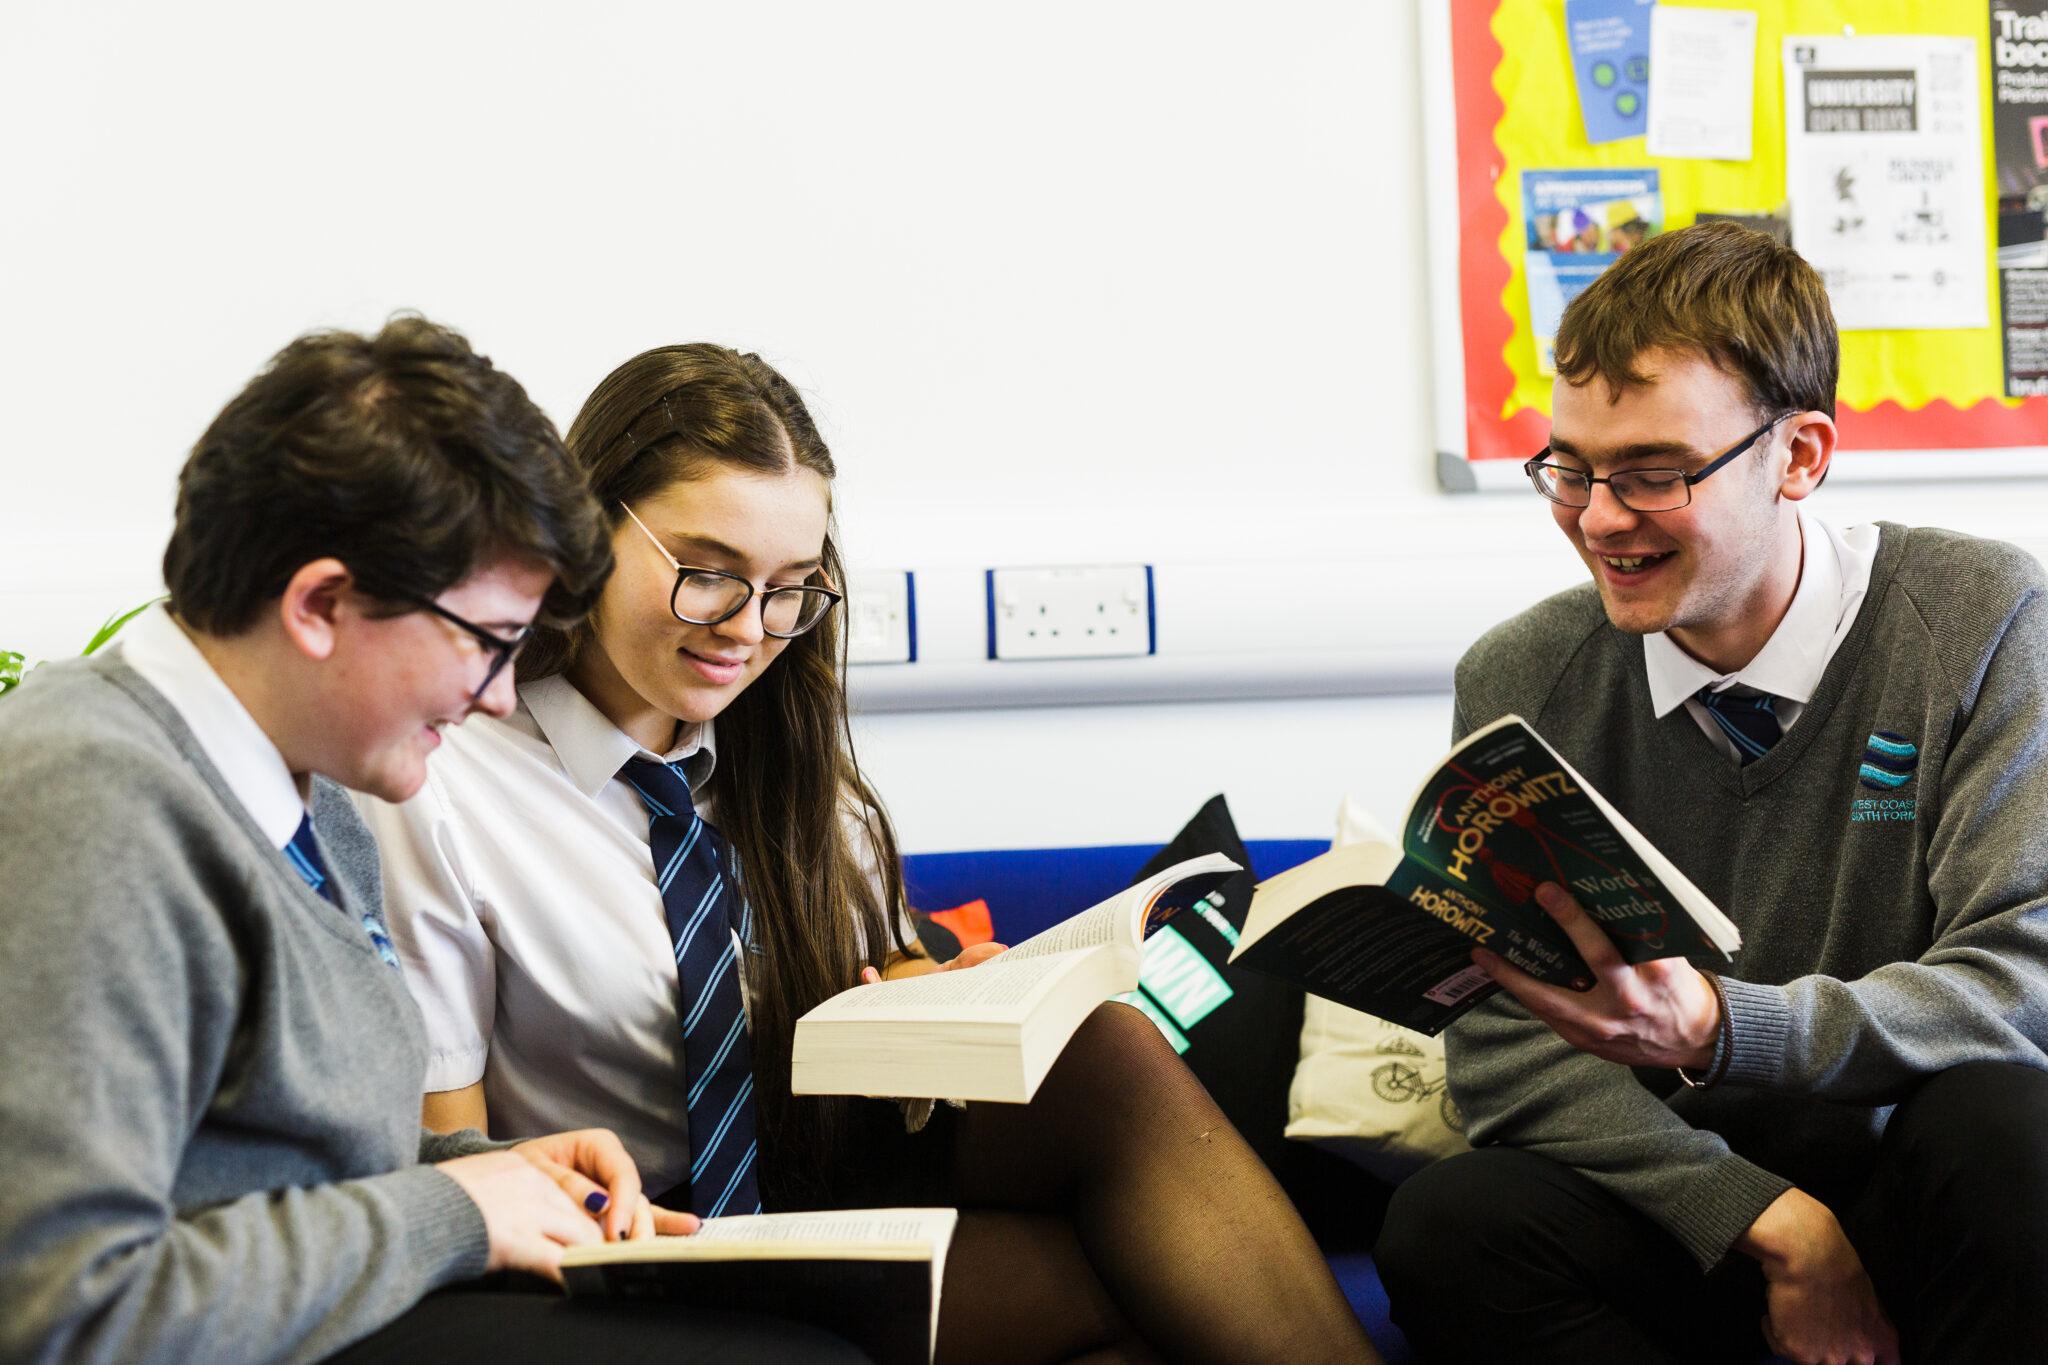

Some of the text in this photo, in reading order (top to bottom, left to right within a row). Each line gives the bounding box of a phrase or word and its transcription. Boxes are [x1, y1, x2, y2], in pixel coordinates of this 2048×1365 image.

[1808, 78, 1915, 107] UNIVERSITY
[1809, 108, 1860, 131] OPEN
[1863, 108, 1911, 131] DAYS
[1454, 765, 1526, 826] ANTHONY
[1447, 771, 1579, 882] HOROWITZ
[1572, 868, 1639, 895] Word
[1409, 884, 1496, 945] HOROWITZ
[1442, 887, 1488, 918] ANTHONY
[1504, 947, 1548, 978] Murder
[1526, 937, 1558, 964] Word
[1141, 932, 1221, 1018] WN
